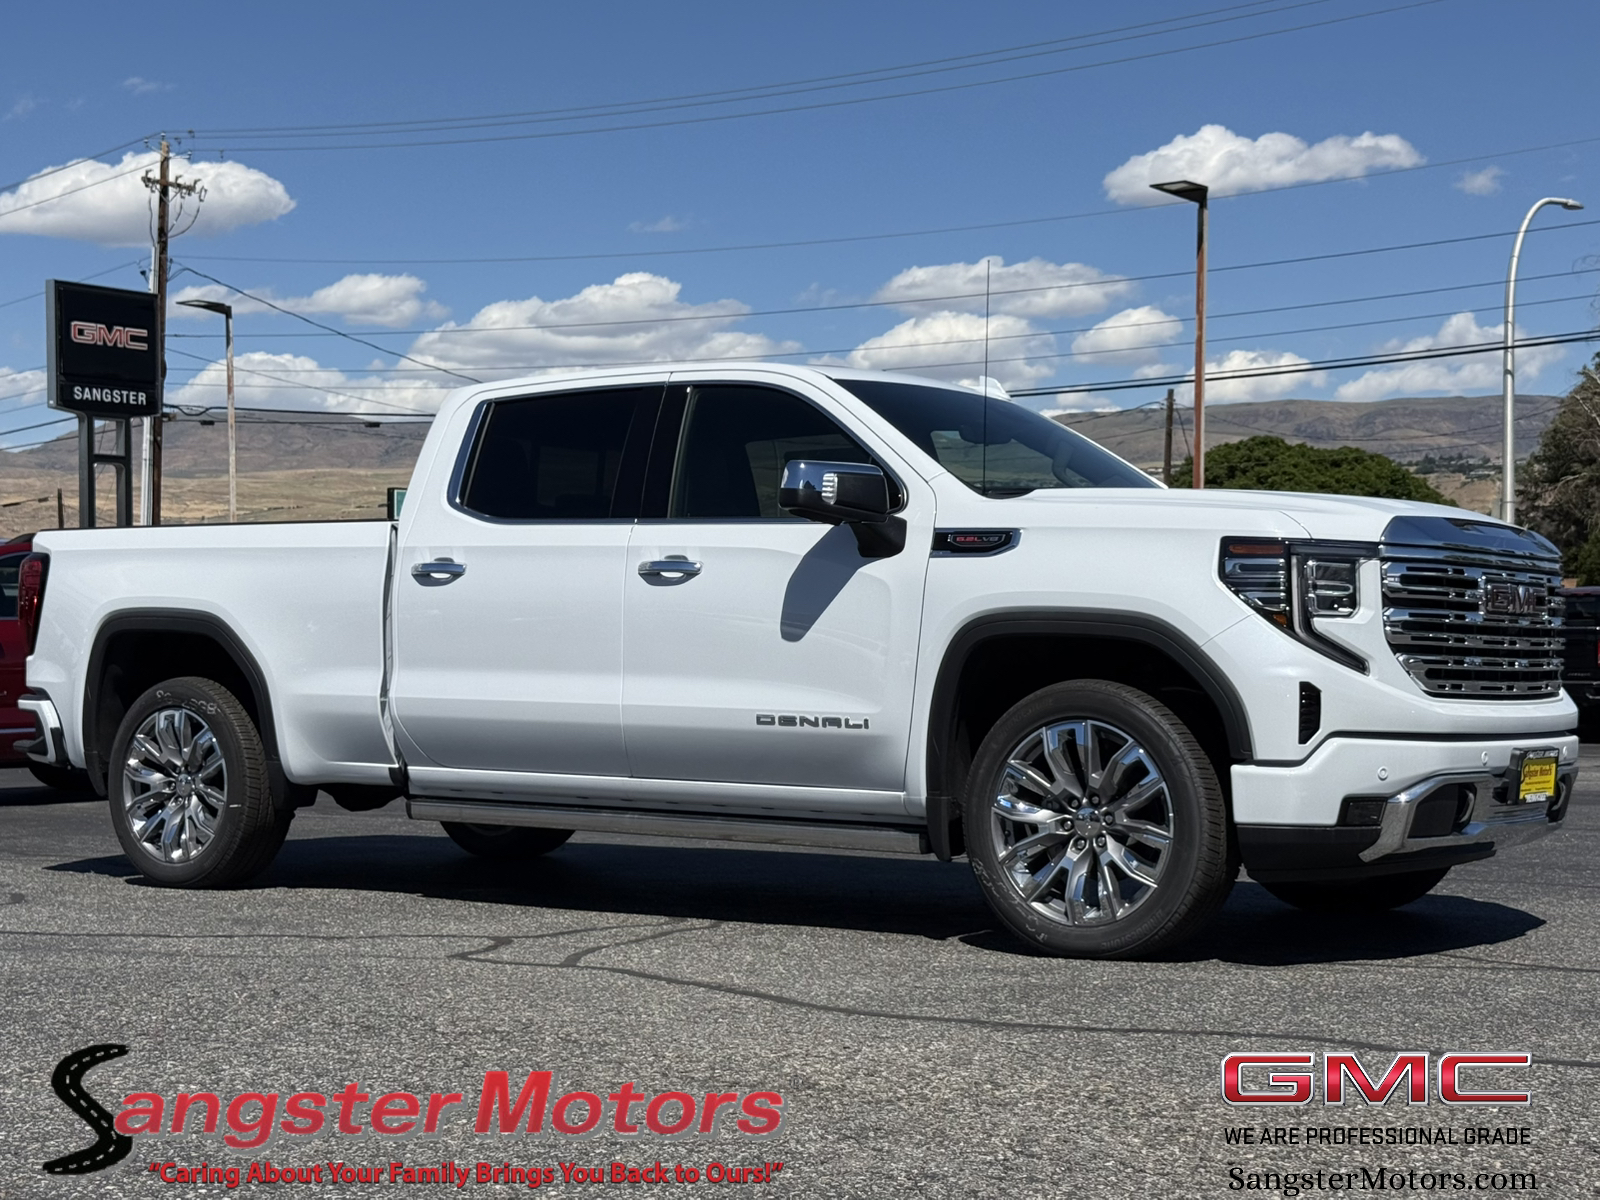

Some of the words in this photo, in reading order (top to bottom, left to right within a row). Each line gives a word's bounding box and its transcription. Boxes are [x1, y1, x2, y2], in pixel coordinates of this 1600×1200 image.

[71, 321, 148, 350] GMC
[73, 386, 147, 406] SANGSTER
[1484, 583, 1548, 613] GMC
[756, 713, 869, 730] DENALI
